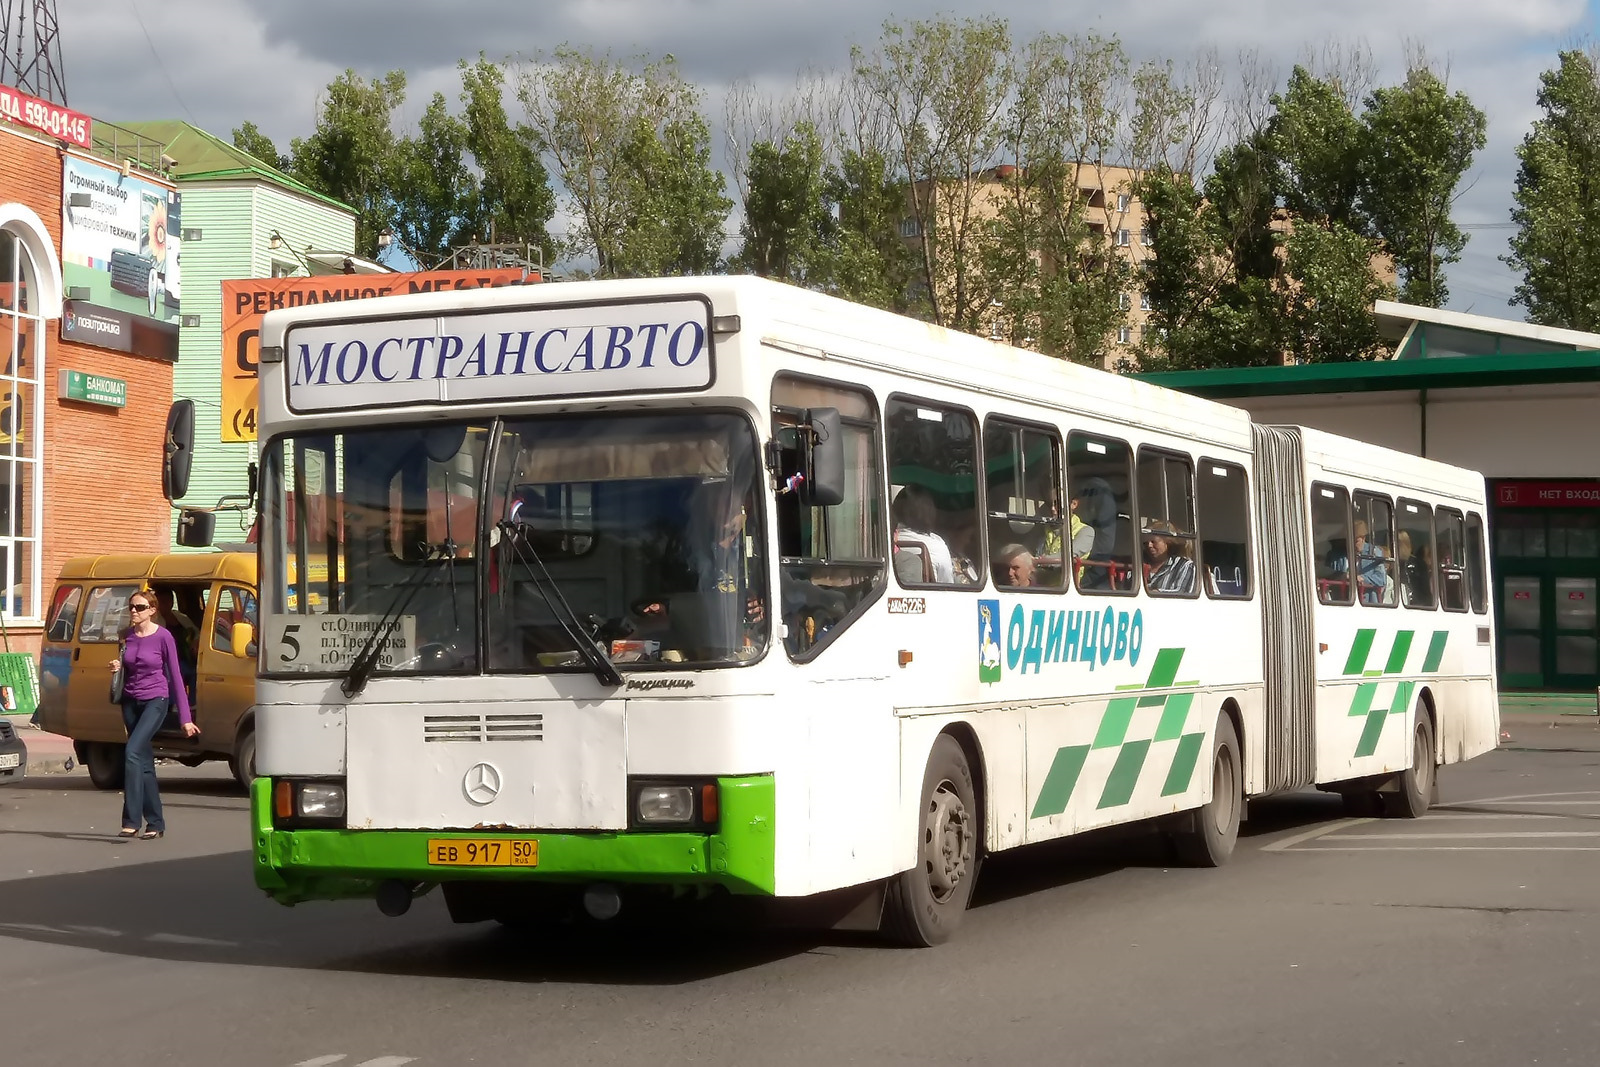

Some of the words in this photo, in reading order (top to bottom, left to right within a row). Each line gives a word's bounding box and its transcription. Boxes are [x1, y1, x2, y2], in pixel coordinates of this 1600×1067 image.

[25, 101, 86, 143] 593-01-15
[69, 171, 105, 193] Огромный
[106, 185, 128, 203] выбор
[74, 213, 109, 233] цифровой
[109, 225, 137, 242] техники
[292, 321, 705, 387] МОСТРАНСАВТО
[86, 376, 125, 395] БАНКОМАТ
[1539, 490, 1562, 499] НЕТ
[280, 625, 301, 662] 5
[321, 633, 407, 652] пл.Трехорка
[1006, 603, 1143, 675] ОДИНЦОВО
[437, 846, 458, 862] ЕВ
[466, 842, 501, 862] 917
[513, 842, 532, 857] 50
